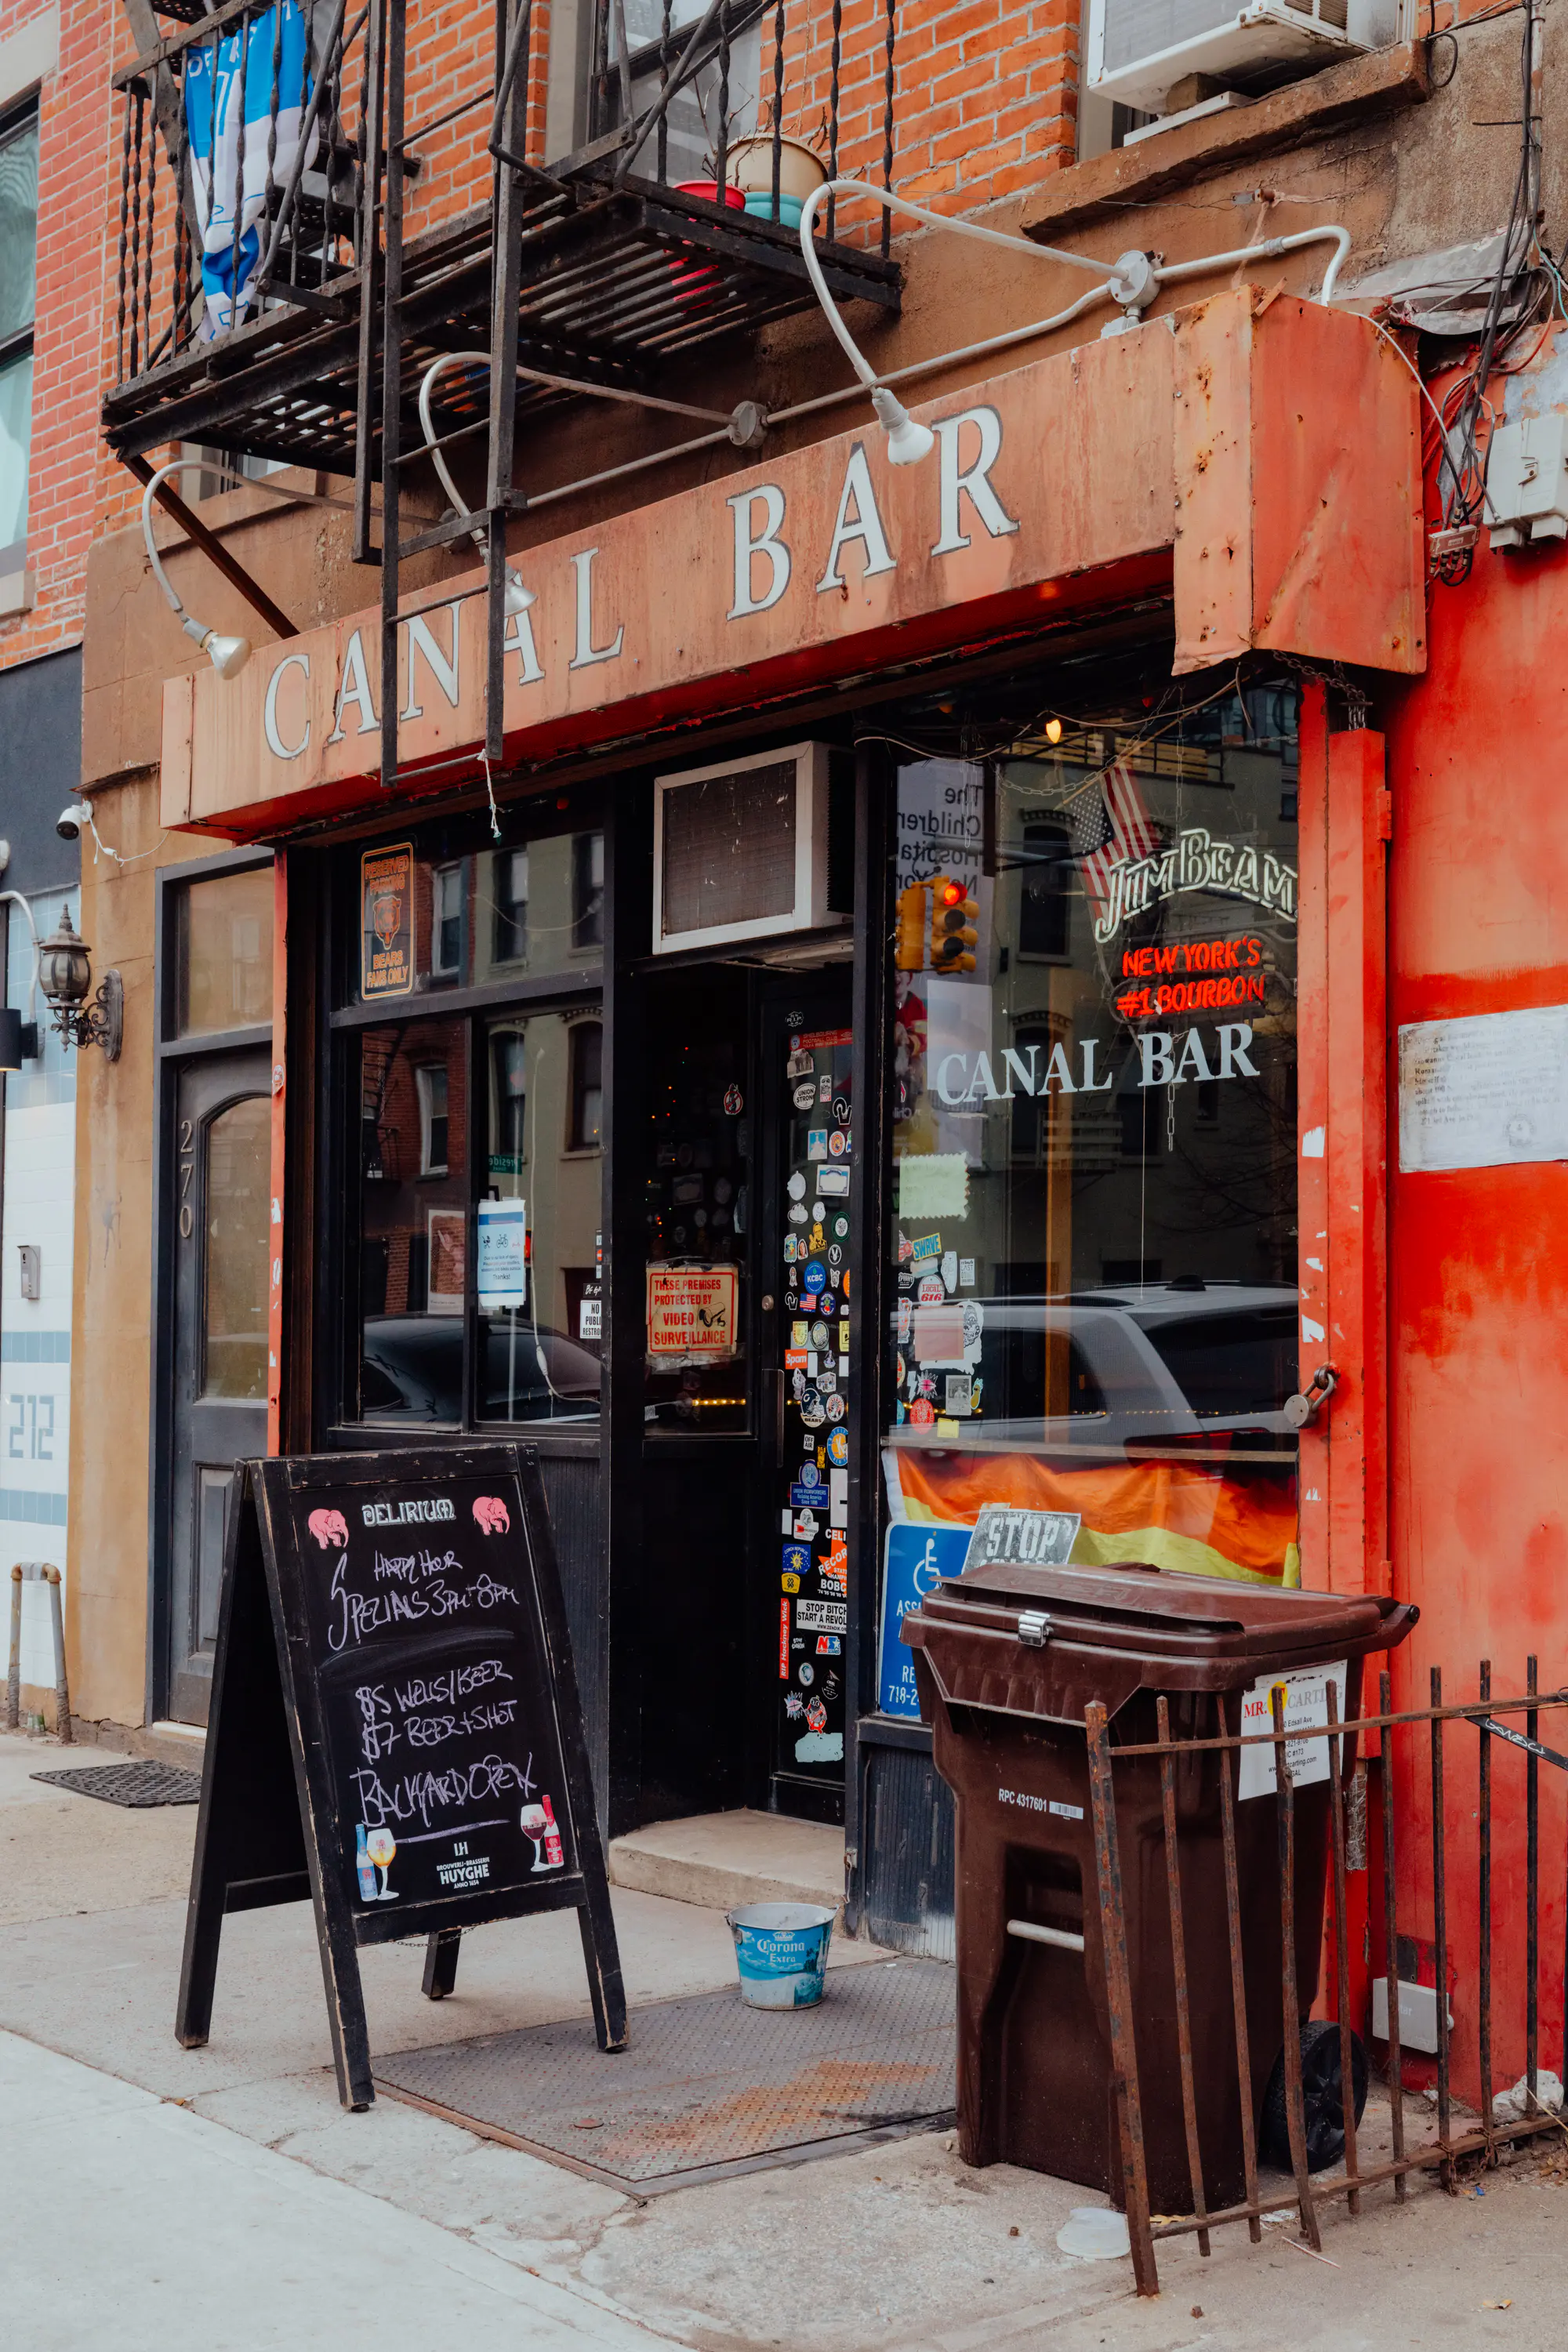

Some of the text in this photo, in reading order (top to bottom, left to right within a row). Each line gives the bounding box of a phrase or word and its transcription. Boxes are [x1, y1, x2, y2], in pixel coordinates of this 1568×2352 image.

[263, 404, 1021, 760] CANAL BAR
[365, 855, 408, 880] RESERVED
[369, 873, 405, 895] PARKING
[1095, 828, 1298, 942] JIM BEAM
[372, 950, 403, 969] BEARS
[1123, 937, 1262, 978] NEW YORK'S
[366, 965, 408, 988] FANS ONLY
[1117, 975, 1265, 1017] #1 BOURBON
[803, 1030, 838, 1039] SHELBOURNE
[936, 1023, 1261, 1105] CANAL BAR
[798, 1087, 815, 1096] UNION
[180, 1120, 194, 1239] 270
[655, 1279, 721, 1290] THESE PREMISES
[807, 1274, 823, 1283] KCBC
[655, 1294, 712, 1305] PROTECTED BY
[921, 1293, 943, 1301] 616
[591, 1304, 600, 1314] NO
[586, 1316, 601, 1326] PUBLI
[662, 1312, 695, 1326] VIDEO
[654, 1330, 725, 1345] SURVEILLANCE
[786, 1353, 807, 1367] Spam
[361, 1498, 456, 1526] DELIRIUM
[986, 1517, 1060, 1559] STOP
[806, 1602, 825, 1613] STOP
[797, 1611, 817, 1621] START
[826, 1615, 847, 1625] REVOL
[1243, 1686, 1343, 1719] MR. CARTIG
[1287, 1717, 1302, 1726] Edsall
[998, 1788, 1047, 1813] RPC 4317601
[439, 1864, 490, 1885] HUYGHE
[757, 1938, 805, 1955] Corona
[769, 1954, 796, 1963] Extra
[1398, 2004, 1413, 2016] tar
